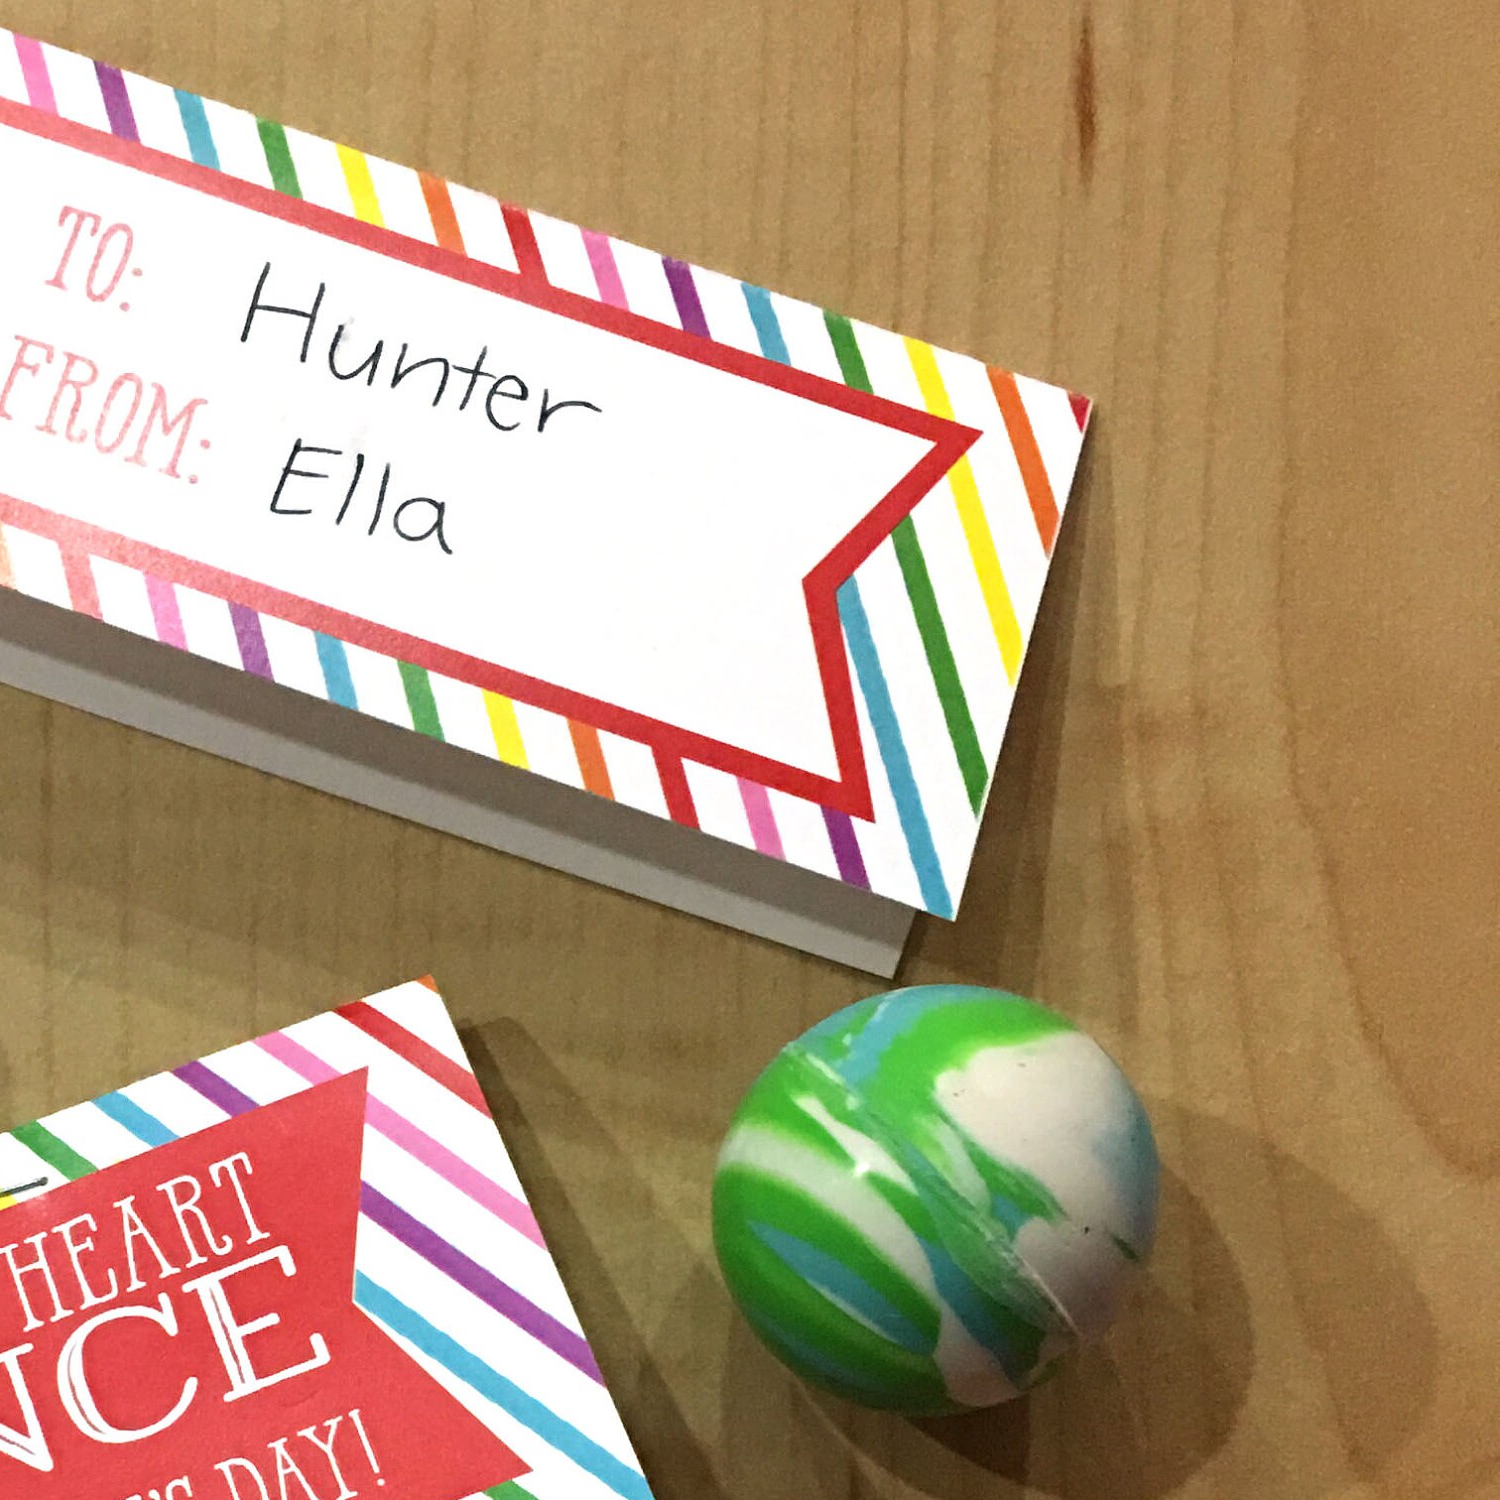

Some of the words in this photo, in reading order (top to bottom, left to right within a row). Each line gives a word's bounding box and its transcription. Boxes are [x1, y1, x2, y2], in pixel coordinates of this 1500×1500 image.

[45, 206, 142, 312] TO:
[239, 262, 602, 435] Hunter
[270, 439, 453, 555] Ella
